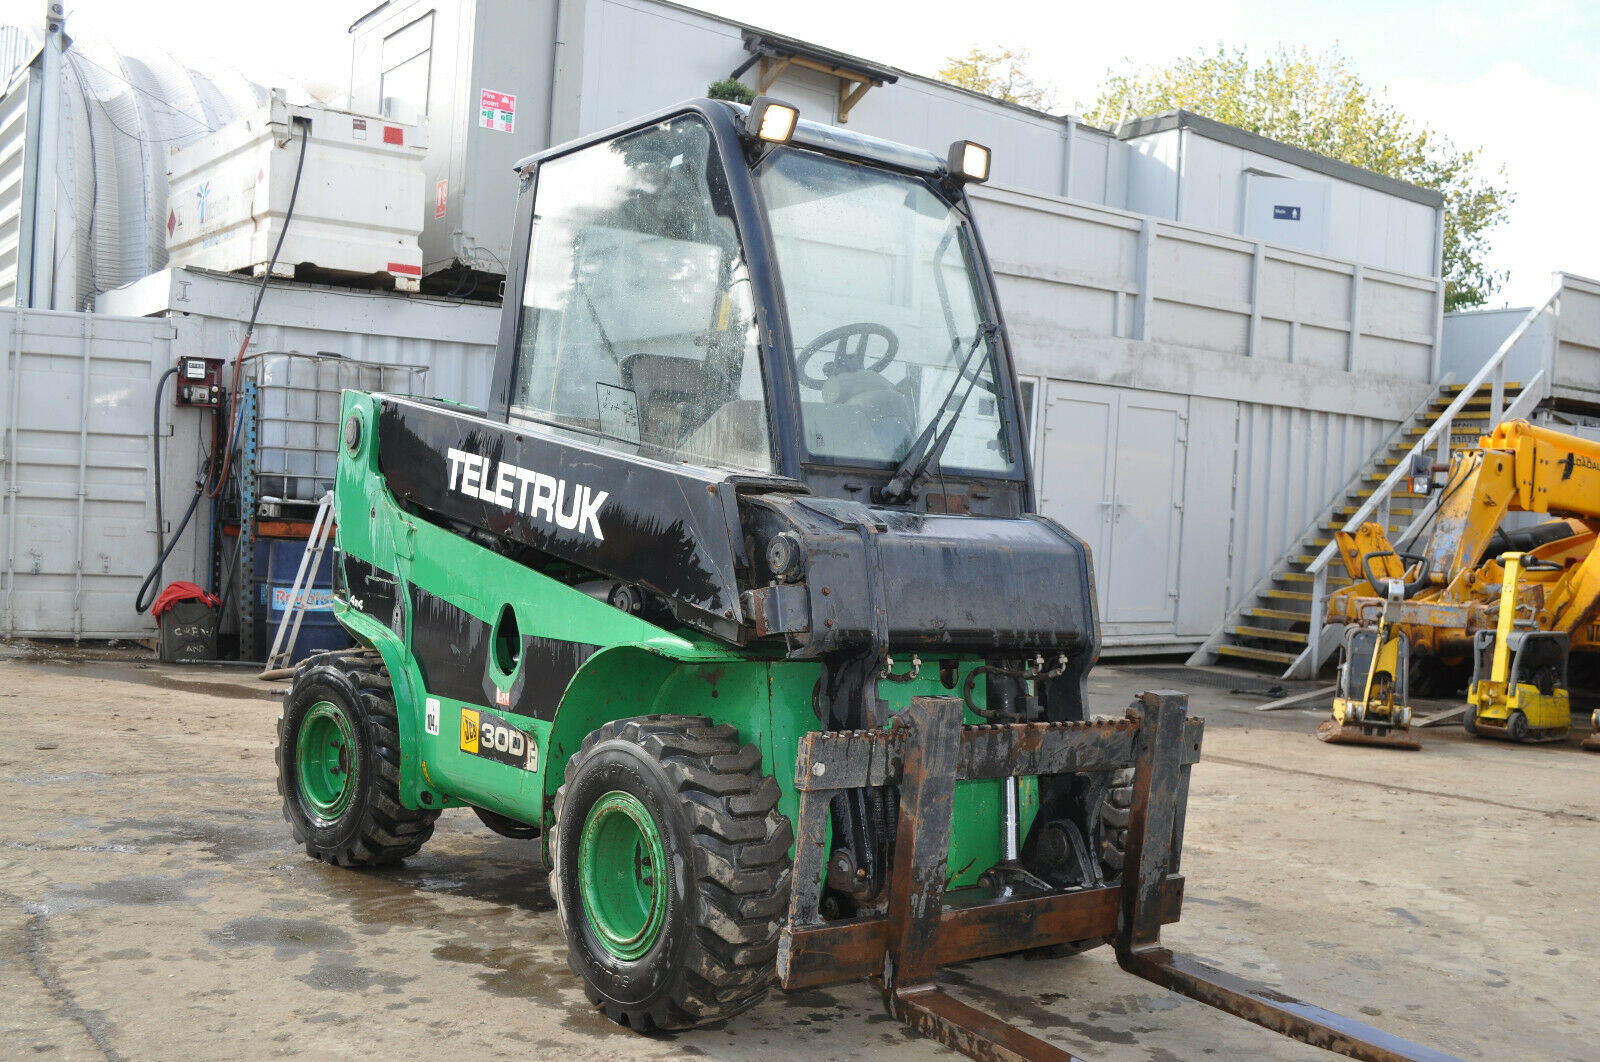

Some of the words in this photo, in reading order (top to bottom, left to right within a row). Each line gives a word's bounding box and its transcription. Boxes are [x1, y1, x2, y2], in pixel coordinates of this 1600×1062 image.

[483, 91, 495, 99] Fire
[447, 447, 610, 541] TELETRUK
[464, 719, 477, 741] JCB
[481, 722, 525, 757] 30D
